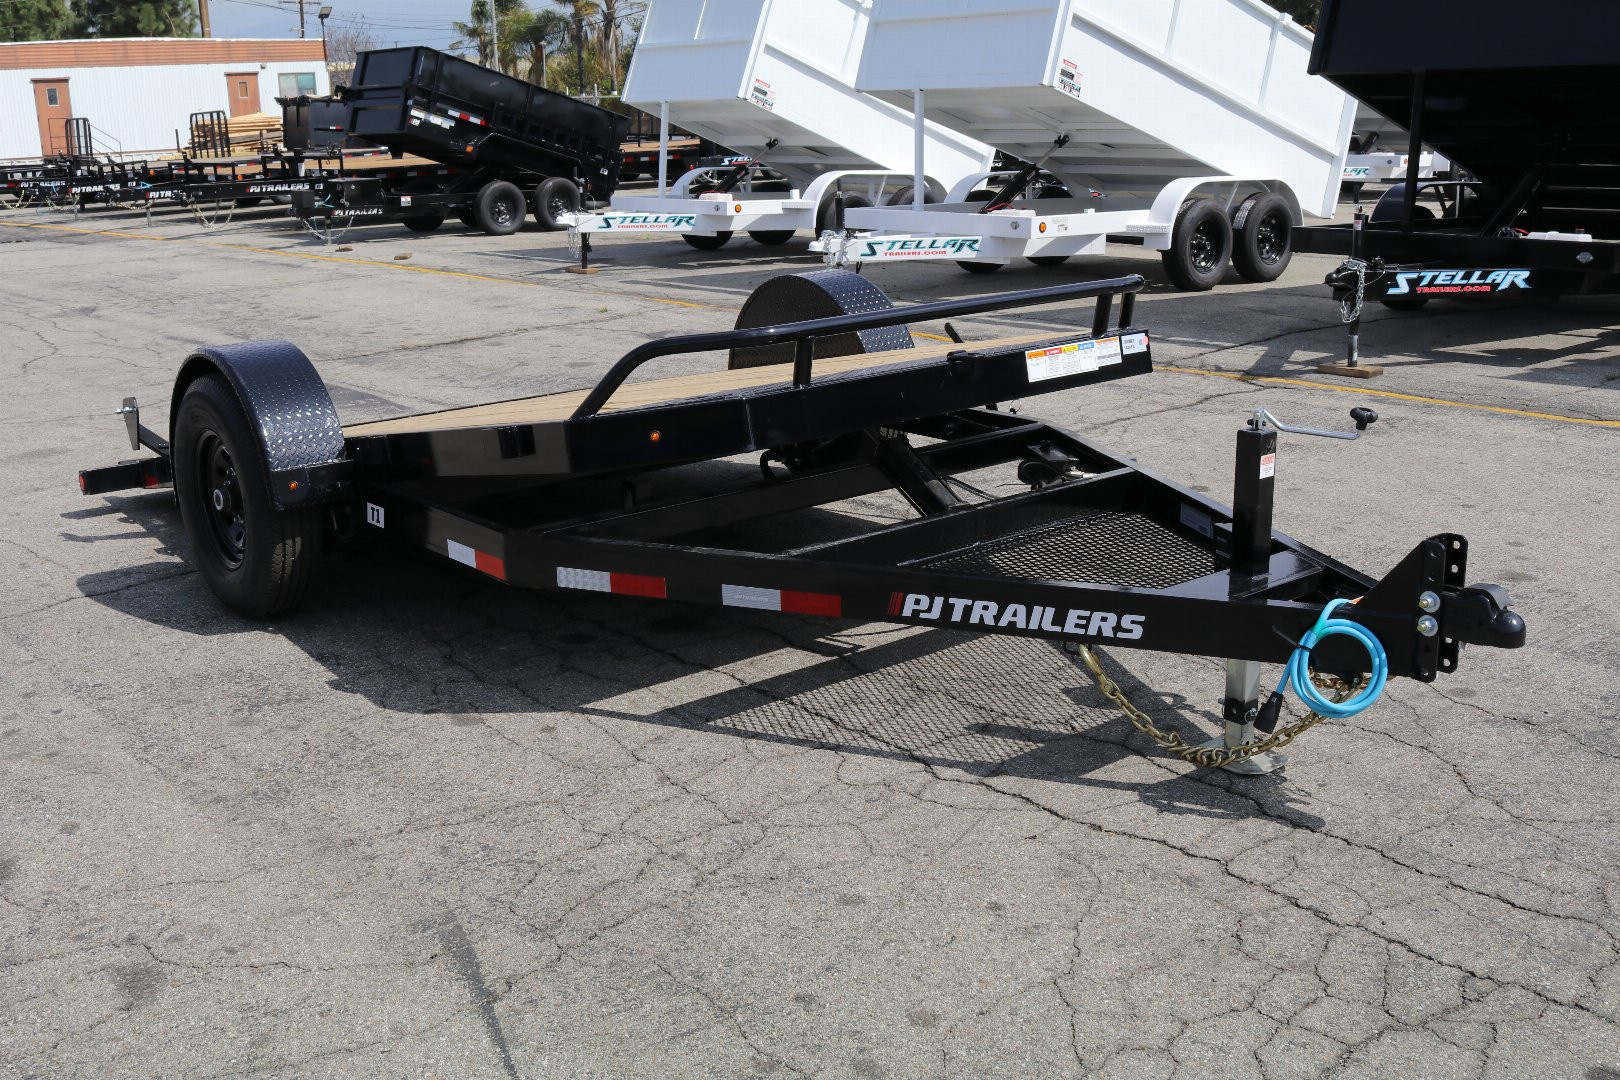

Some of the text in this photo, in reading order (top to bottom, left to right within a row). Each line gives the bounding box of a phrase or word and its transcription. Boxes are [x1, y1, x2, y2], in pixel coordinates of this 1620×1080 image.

[81, 183, 121, 192] TRAILRS
[250, 185, 261, 193] PJ
[261, 182, 310, 192] TRAILERS
[598, 215, 697, 229] STELLAR
[860, 238, 981, 256] STELLAR
[1386, 270, 1532, 294] STELLAR
[1416, 285, 1491, 294] TRAILERS.COM
[371, 507, 380, 524] T1
[902, 593, 1146, 640] PJ TRAILERS
